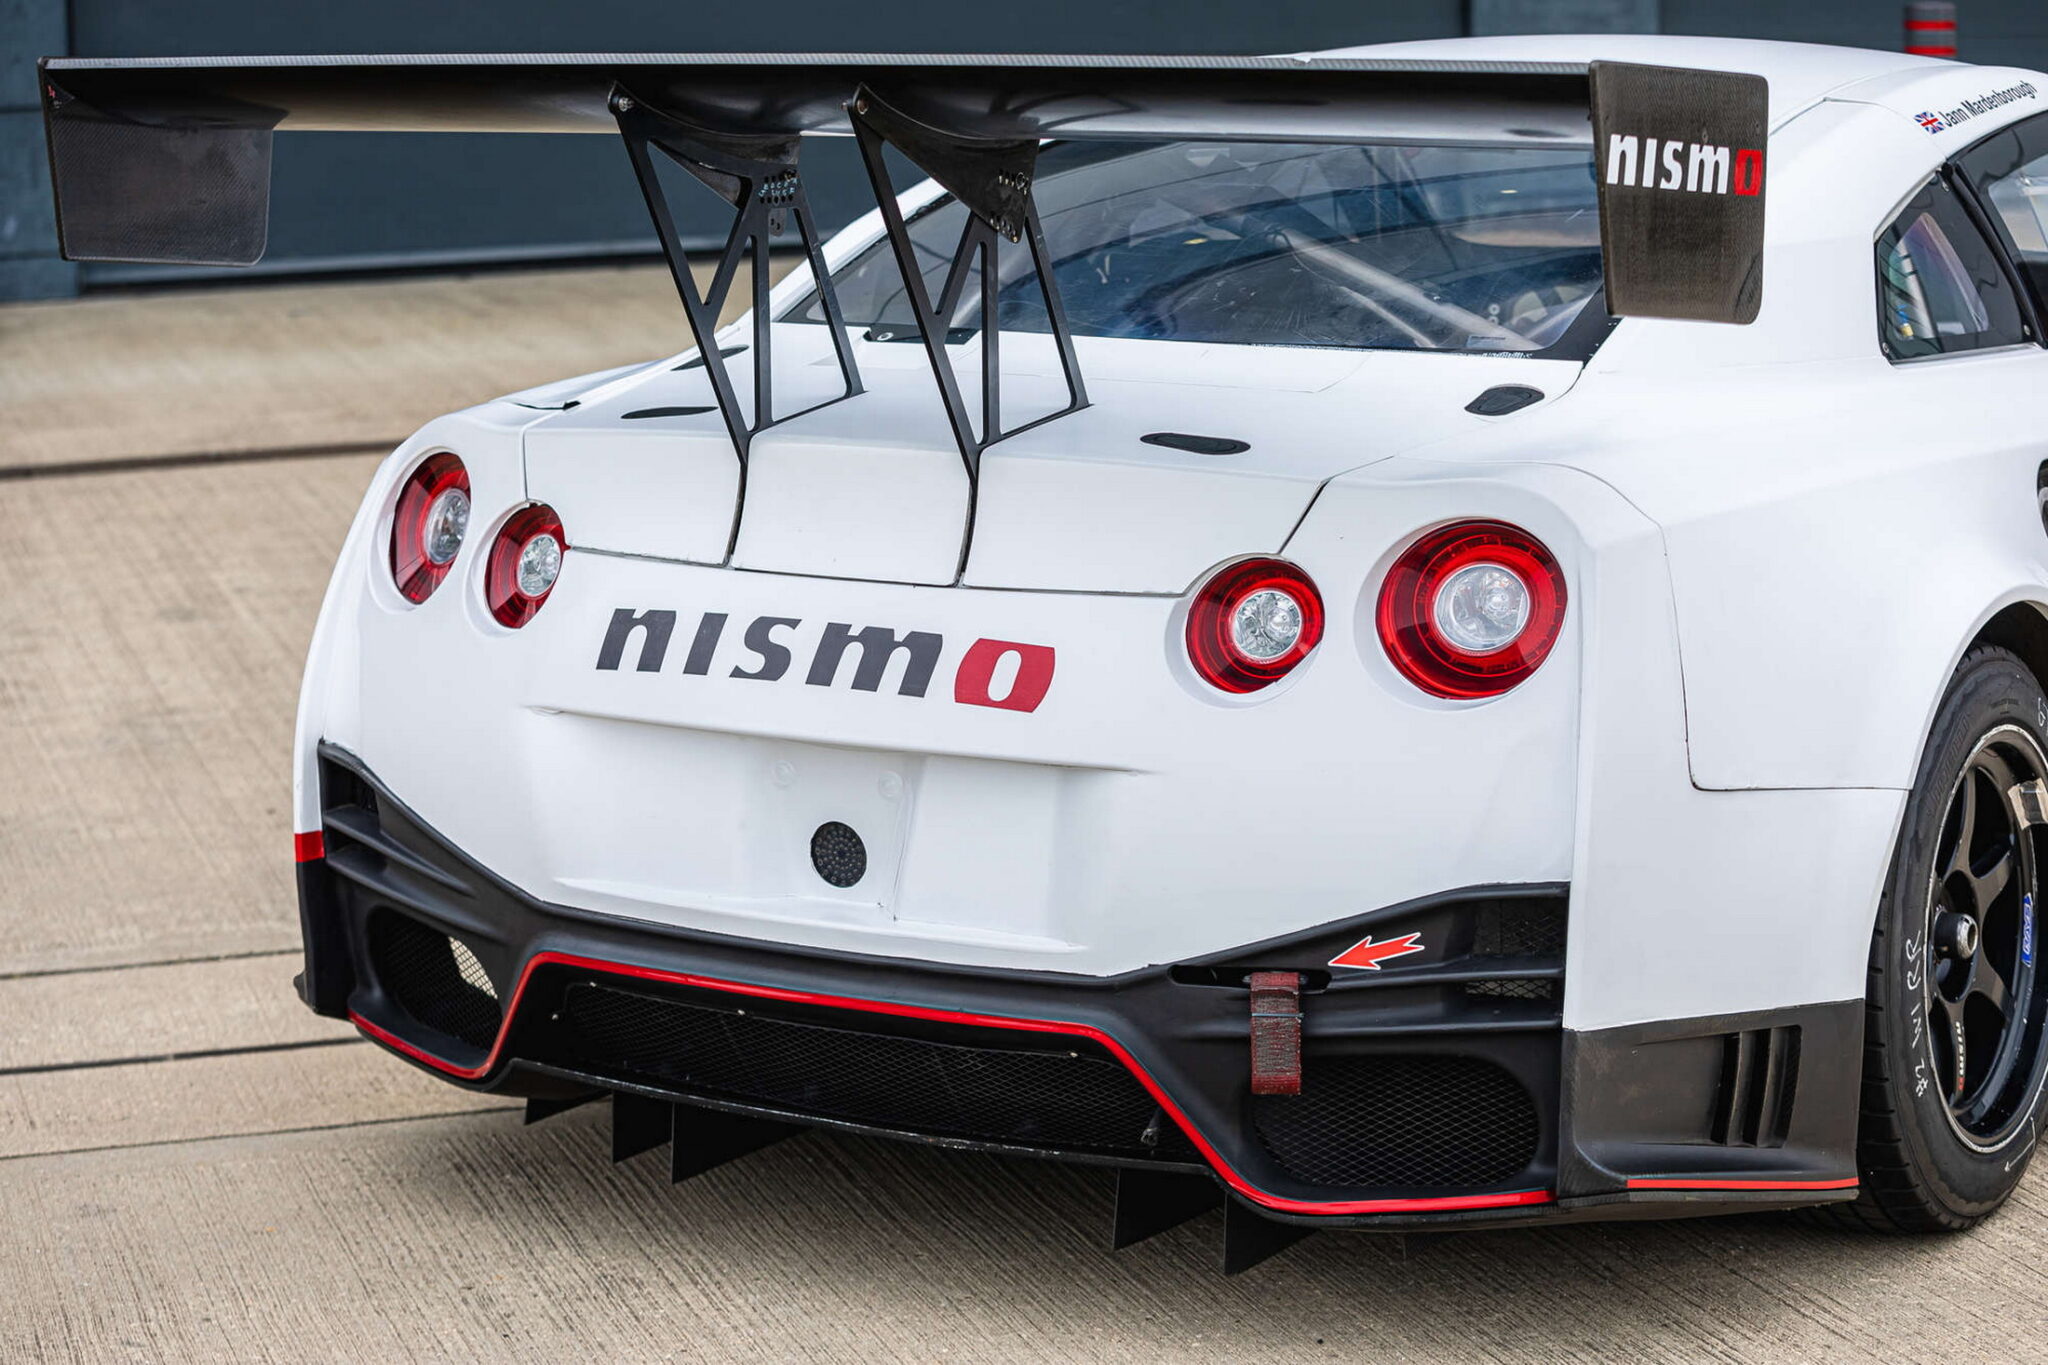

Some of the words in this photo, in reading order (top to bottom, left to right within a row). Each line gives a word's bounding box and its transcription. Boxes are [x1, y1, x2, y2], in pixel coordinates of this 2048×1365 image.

[1938, 108, 1970, 127] Jann
[1961, 80, 2038, 117] Mardenborough
[1606, 134, 1763, 196] nismo
[596, 608, 1056, 713] nismo
